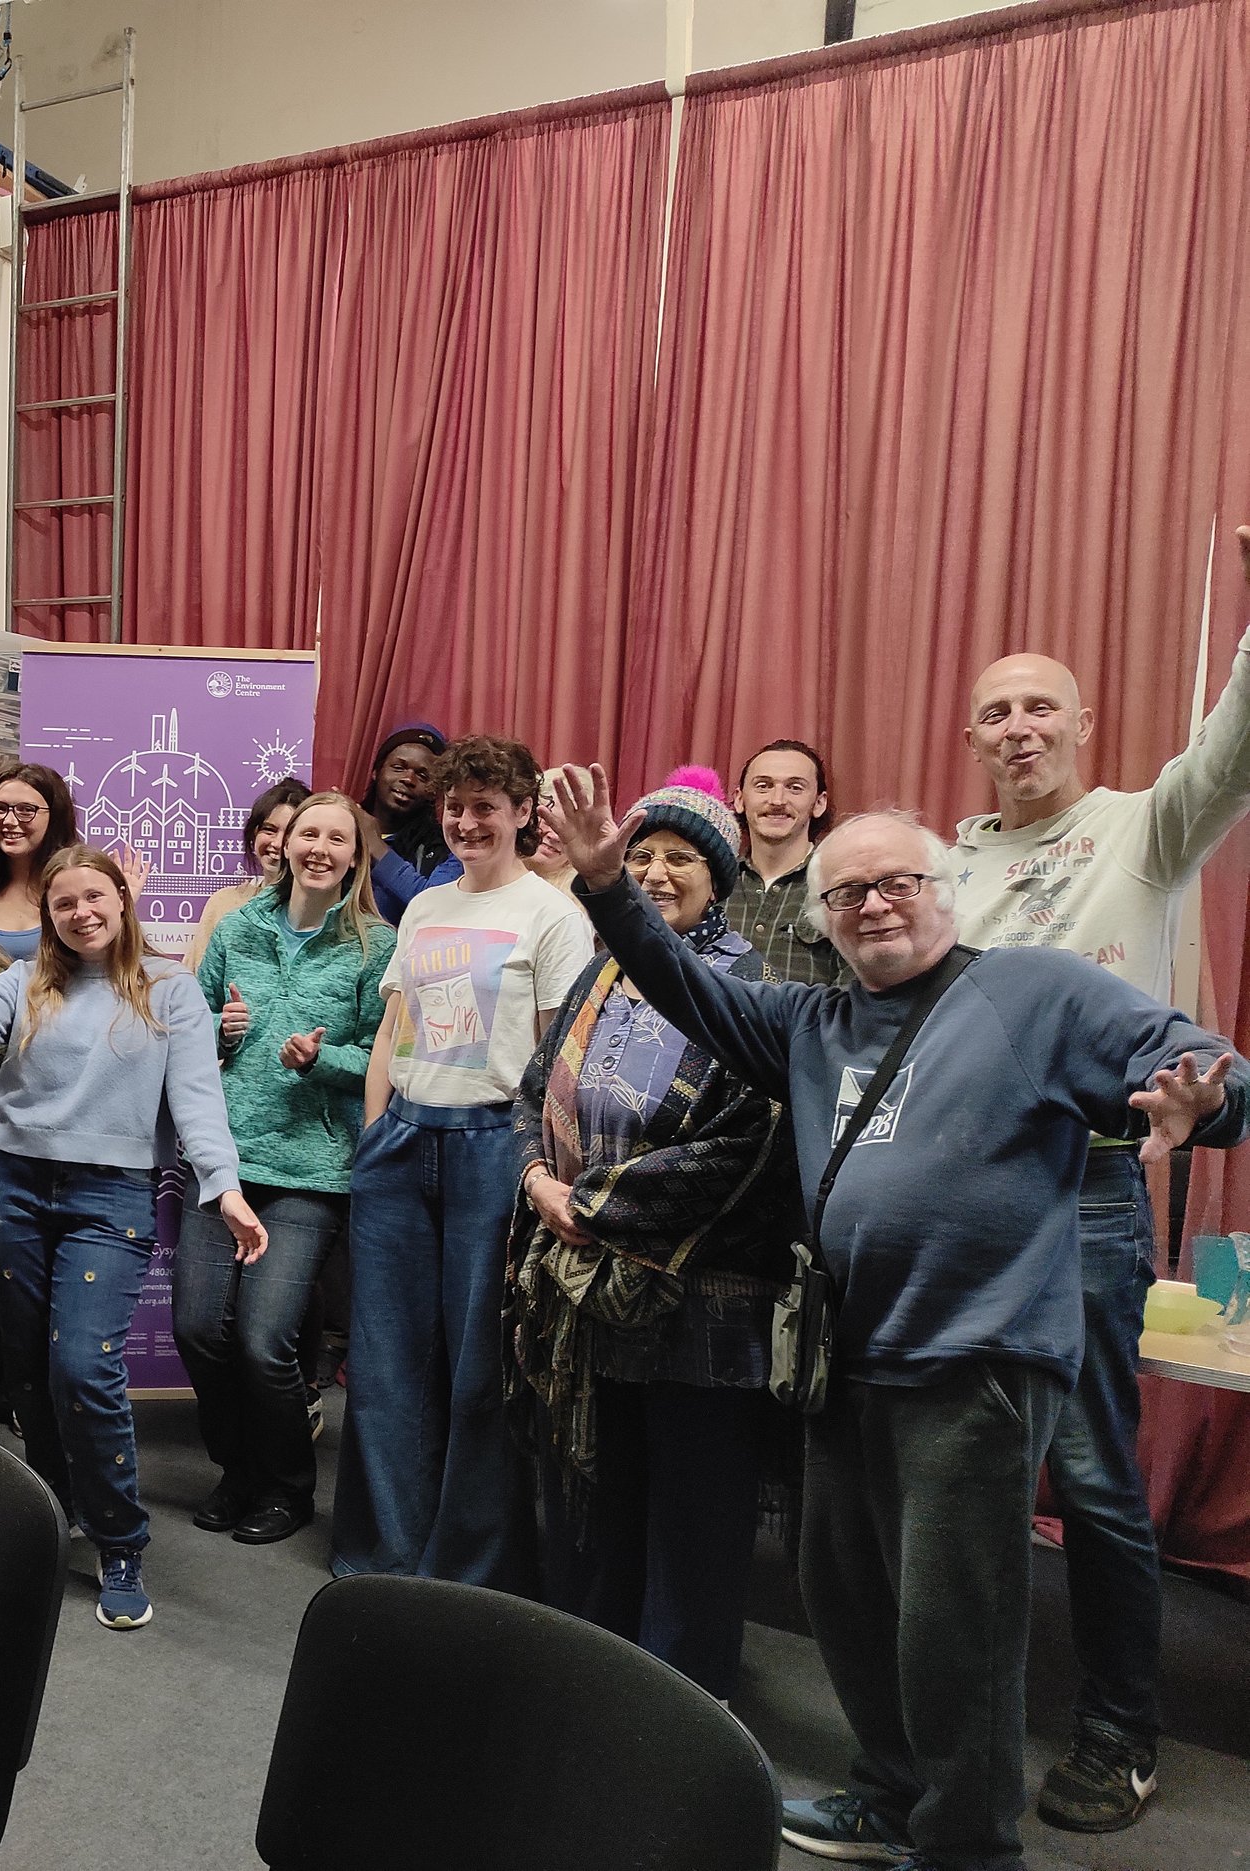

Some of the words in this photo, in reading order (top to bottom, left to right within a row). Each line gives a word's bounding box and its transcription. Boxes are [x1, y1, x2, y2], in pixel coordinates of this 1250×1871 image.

[235, 675, 251, 683] The
[235, 682, 286, 691] Environment
[235, 689, 261, 697] Centre
[1005, 931, 1035, 942] GOODS
[152, 1243, 176, 1259] Cysy
